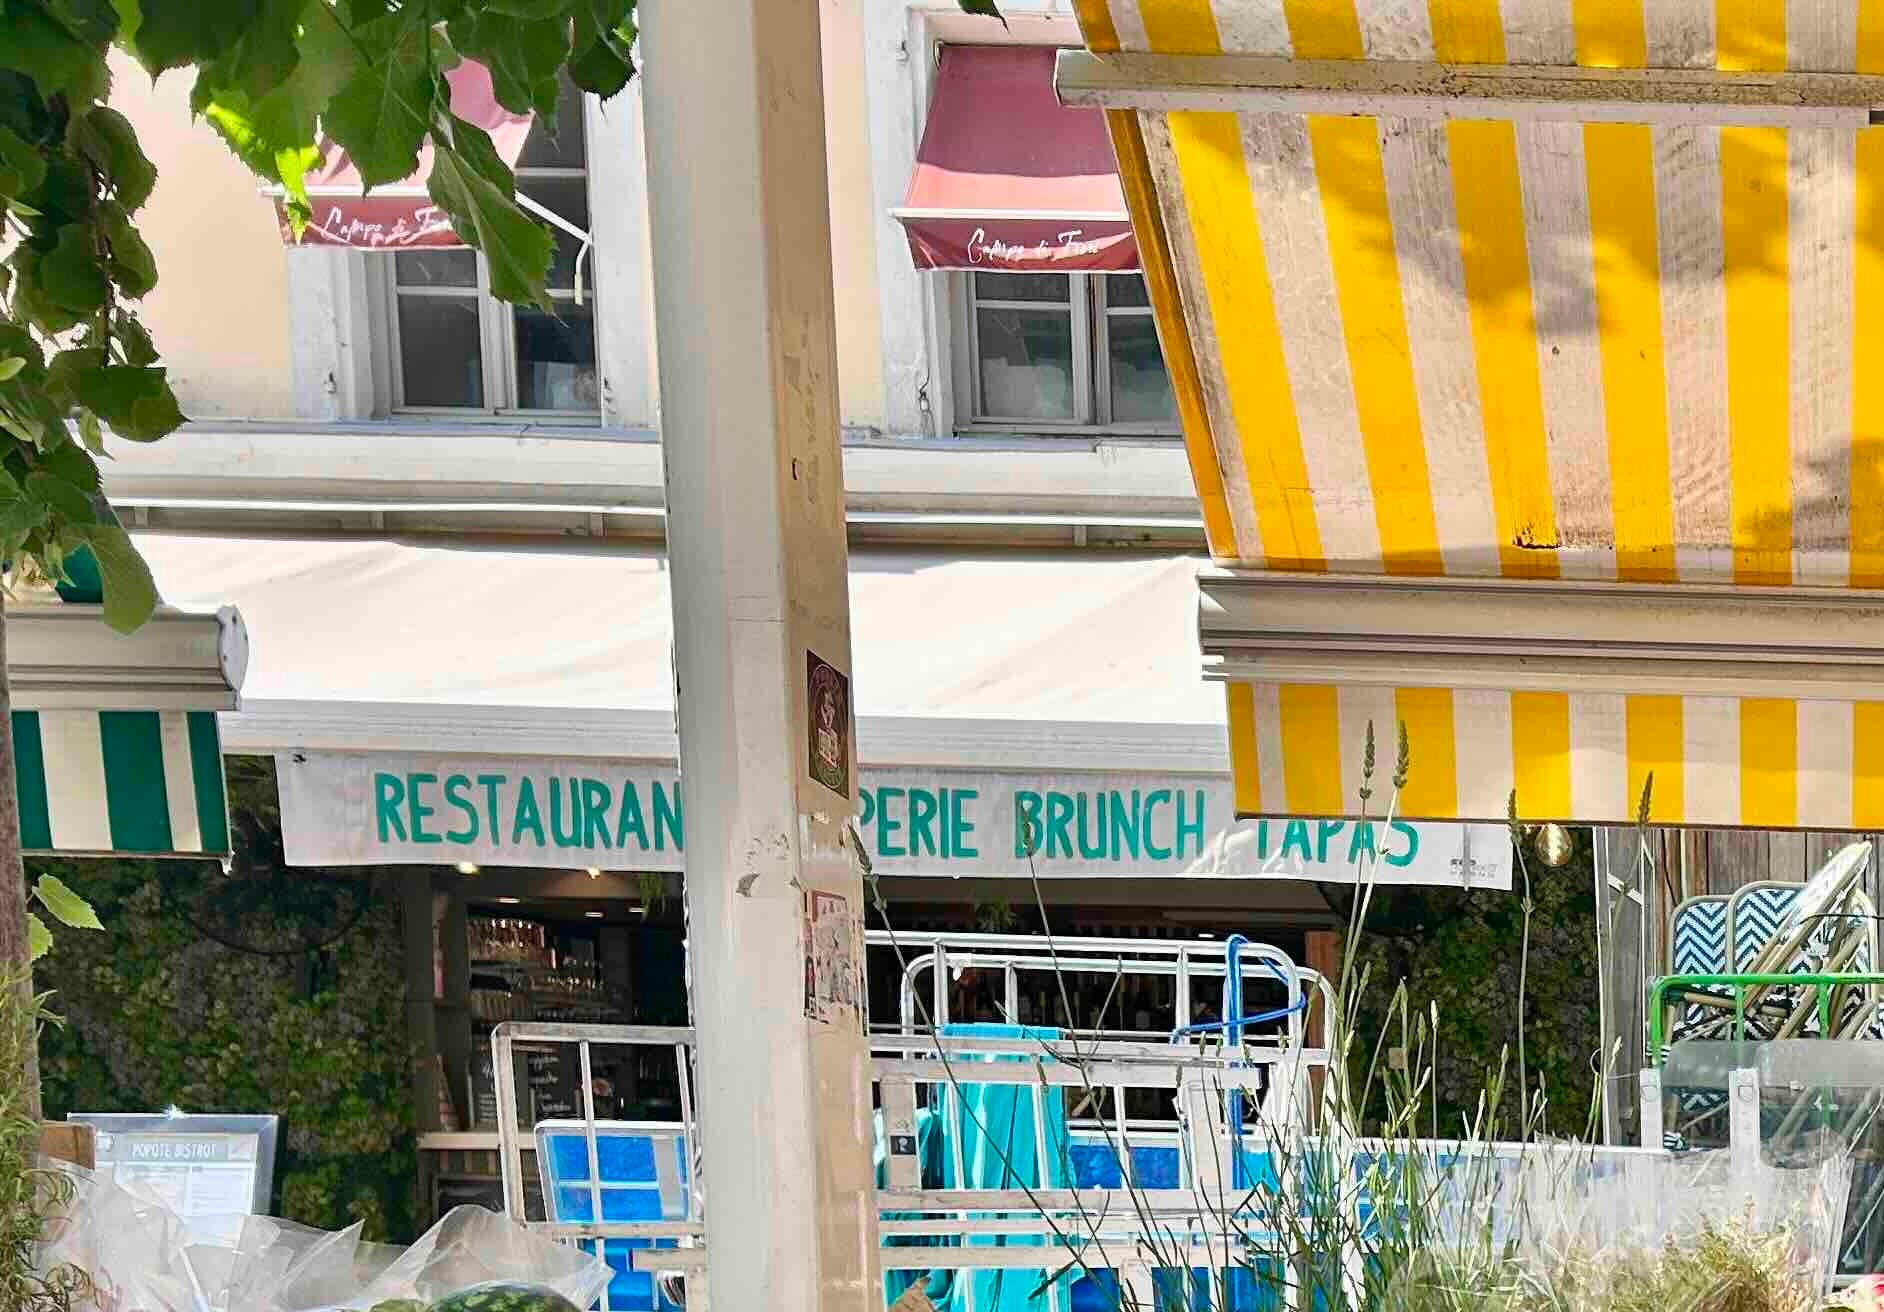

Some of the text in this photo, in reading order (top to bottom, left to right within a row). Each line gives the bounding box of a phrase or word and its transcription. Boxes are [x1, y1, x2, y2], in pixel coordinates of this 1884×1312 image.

[374, 772, 684, 852] RESTAURAN
[858, 785, 979, 859] PERIE
[1014, 788, 1205, 860] BRUNCH
